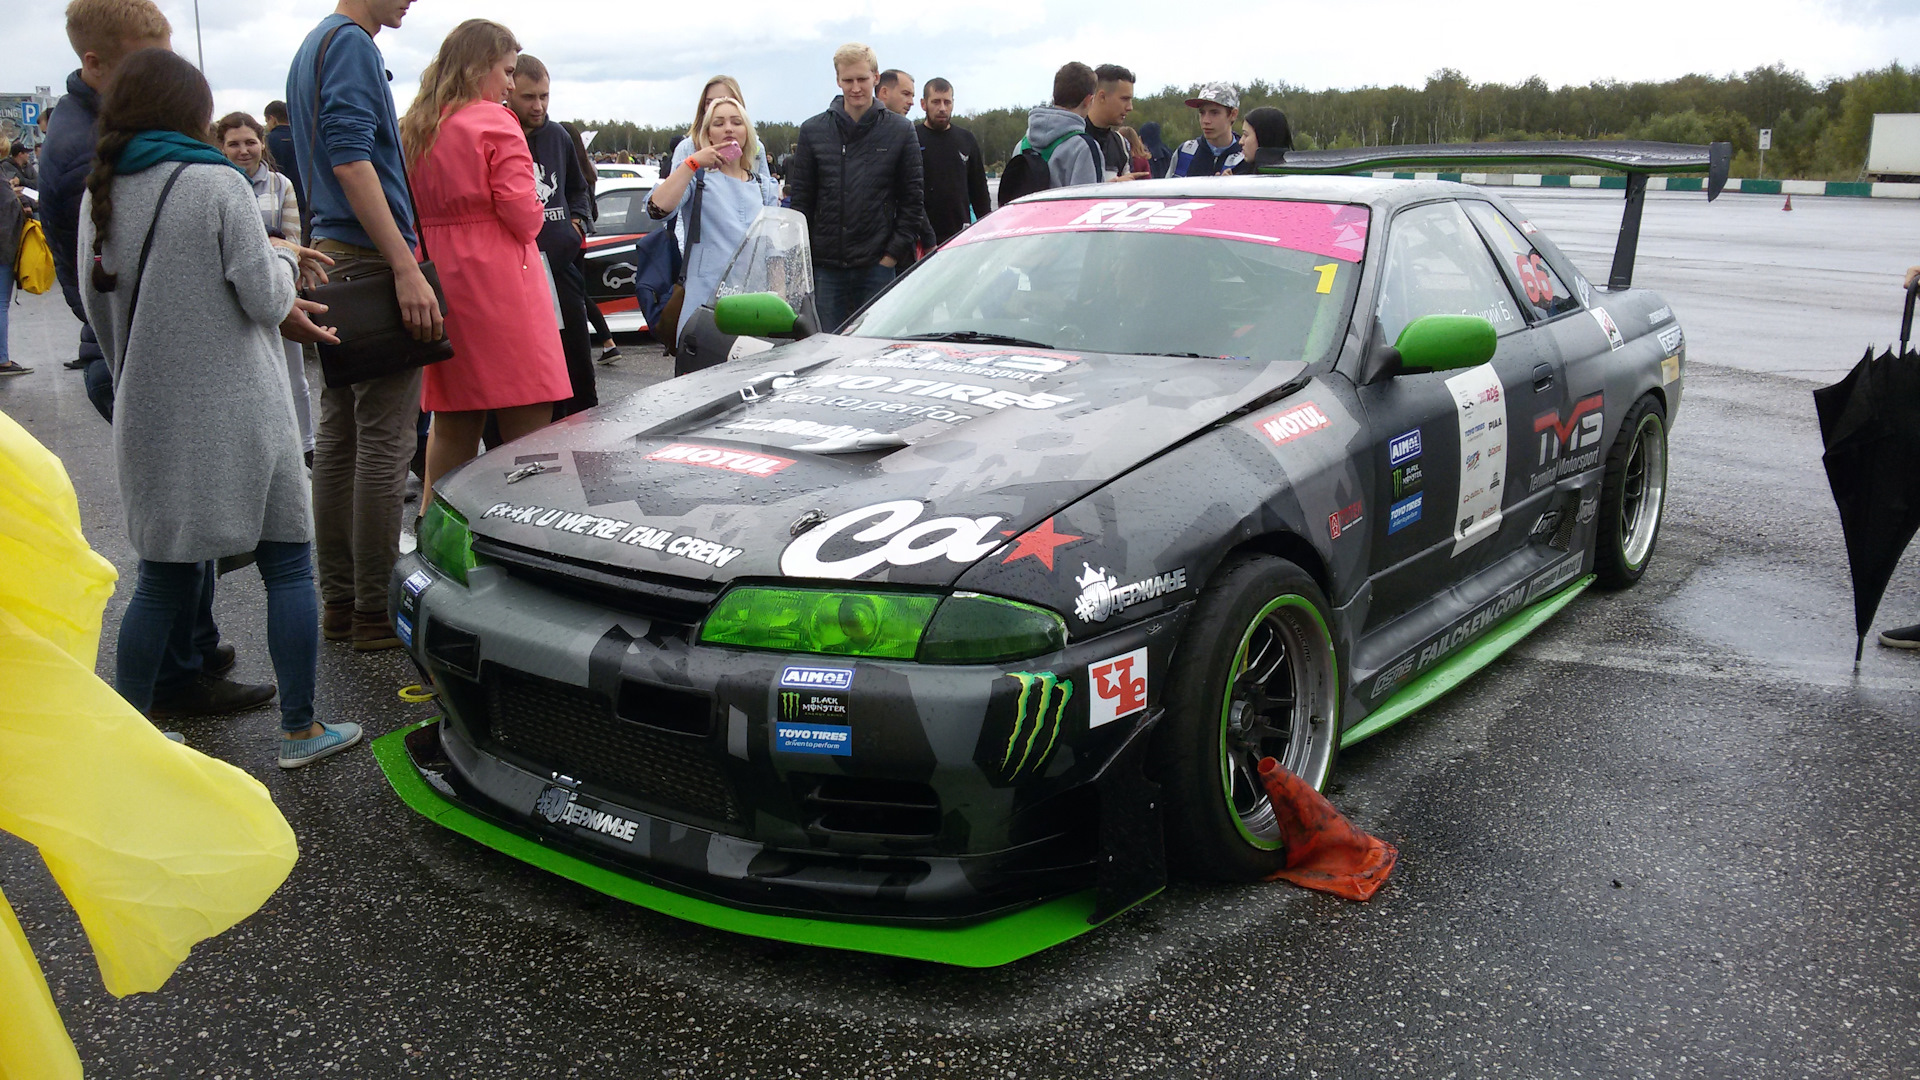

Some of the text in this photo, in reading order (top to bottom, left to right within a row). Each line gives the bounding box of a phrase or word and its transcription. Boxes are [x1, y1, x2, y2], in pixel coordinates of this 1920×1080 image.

[0, 109, 18, 118] LING
[25, 104, 36, 123] P
[1067, 201, 1215, 226] RDS
[1313, 263, 1339, 294] 1
[1517, 253, 1553, 303] 66
[928, 362, 1044, 382] Motorsport
[884, 378, 1074, 410] TIRES
[849, 400, 974, 424] perfor
[1263, 406, 1328, 442] MOTUL
[1392, 436, 1420, 460] AIMOL
[650, 447, 781, 474] MOTUL
[1528, 446, 1600, 492] Terminal Motorsport
[1391, 503, 1407, 520] TOYO
[1405, 497, 1422, 511] TIRES
[535, 508, 561, 529] U
[555, 512, 632, 541] WE'RE
[619, 524, 674, 553] FAIL
[670, 533, 744, 568] CREW
[1417, 586, 1527, 670] FAILCREW.COM
[785, 671, 846, 684] AIMOL
[802, 704, 846, 713] MONSTER
[811, 696, 838, 705] BLACK
[779, 729, 847, 741] TOYO TIRES
[785, 739, 806, 747] driven
[812, 741, 840, 749] perform
